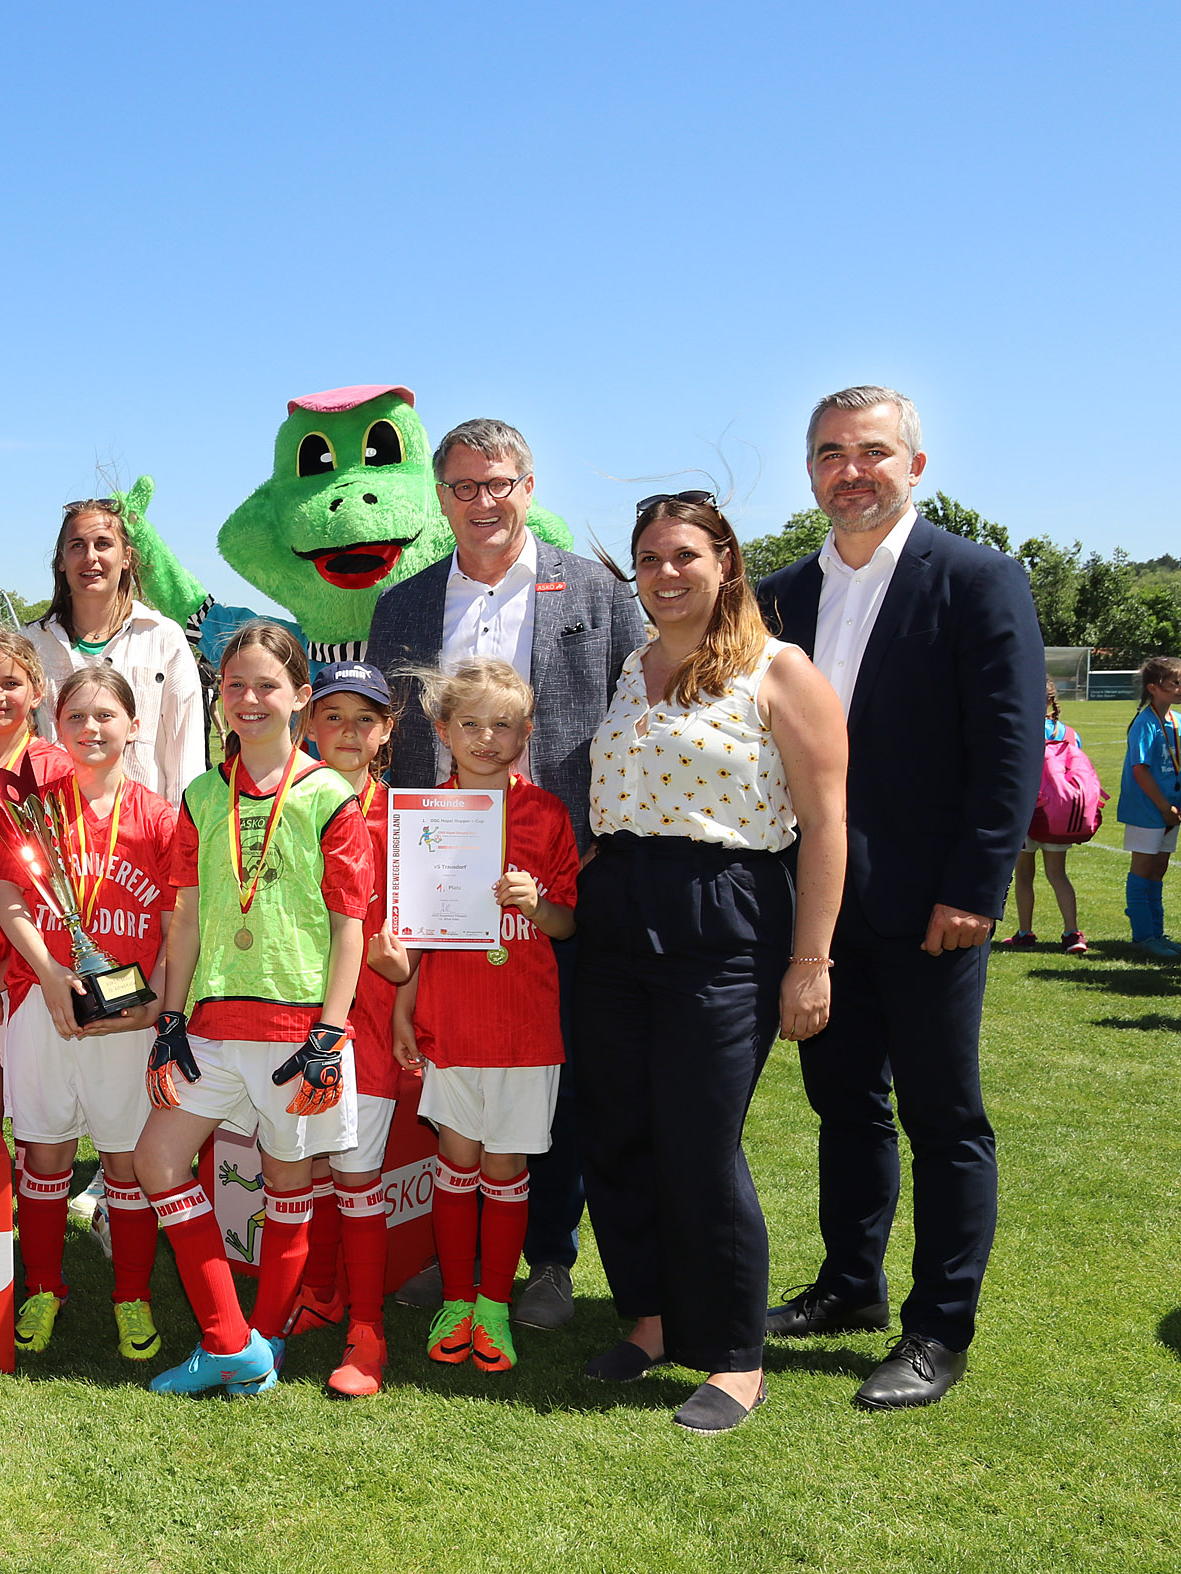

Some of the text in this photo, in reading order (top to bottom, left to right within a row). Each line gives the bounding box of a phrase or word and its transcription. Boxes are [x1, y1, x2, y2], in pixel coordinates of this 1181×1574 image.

[335, 669, 366, 680] PUMA
[422, 798, 465, 807] Urkunde
[241, 815, 265, 828] ASKÖ
[392, 814, 401, 904] WIR BEWEGEN BURGENLAND
[384, 1162, 434, 1218] SKÖ
[156, 1191, 207, 1218] PUMA
